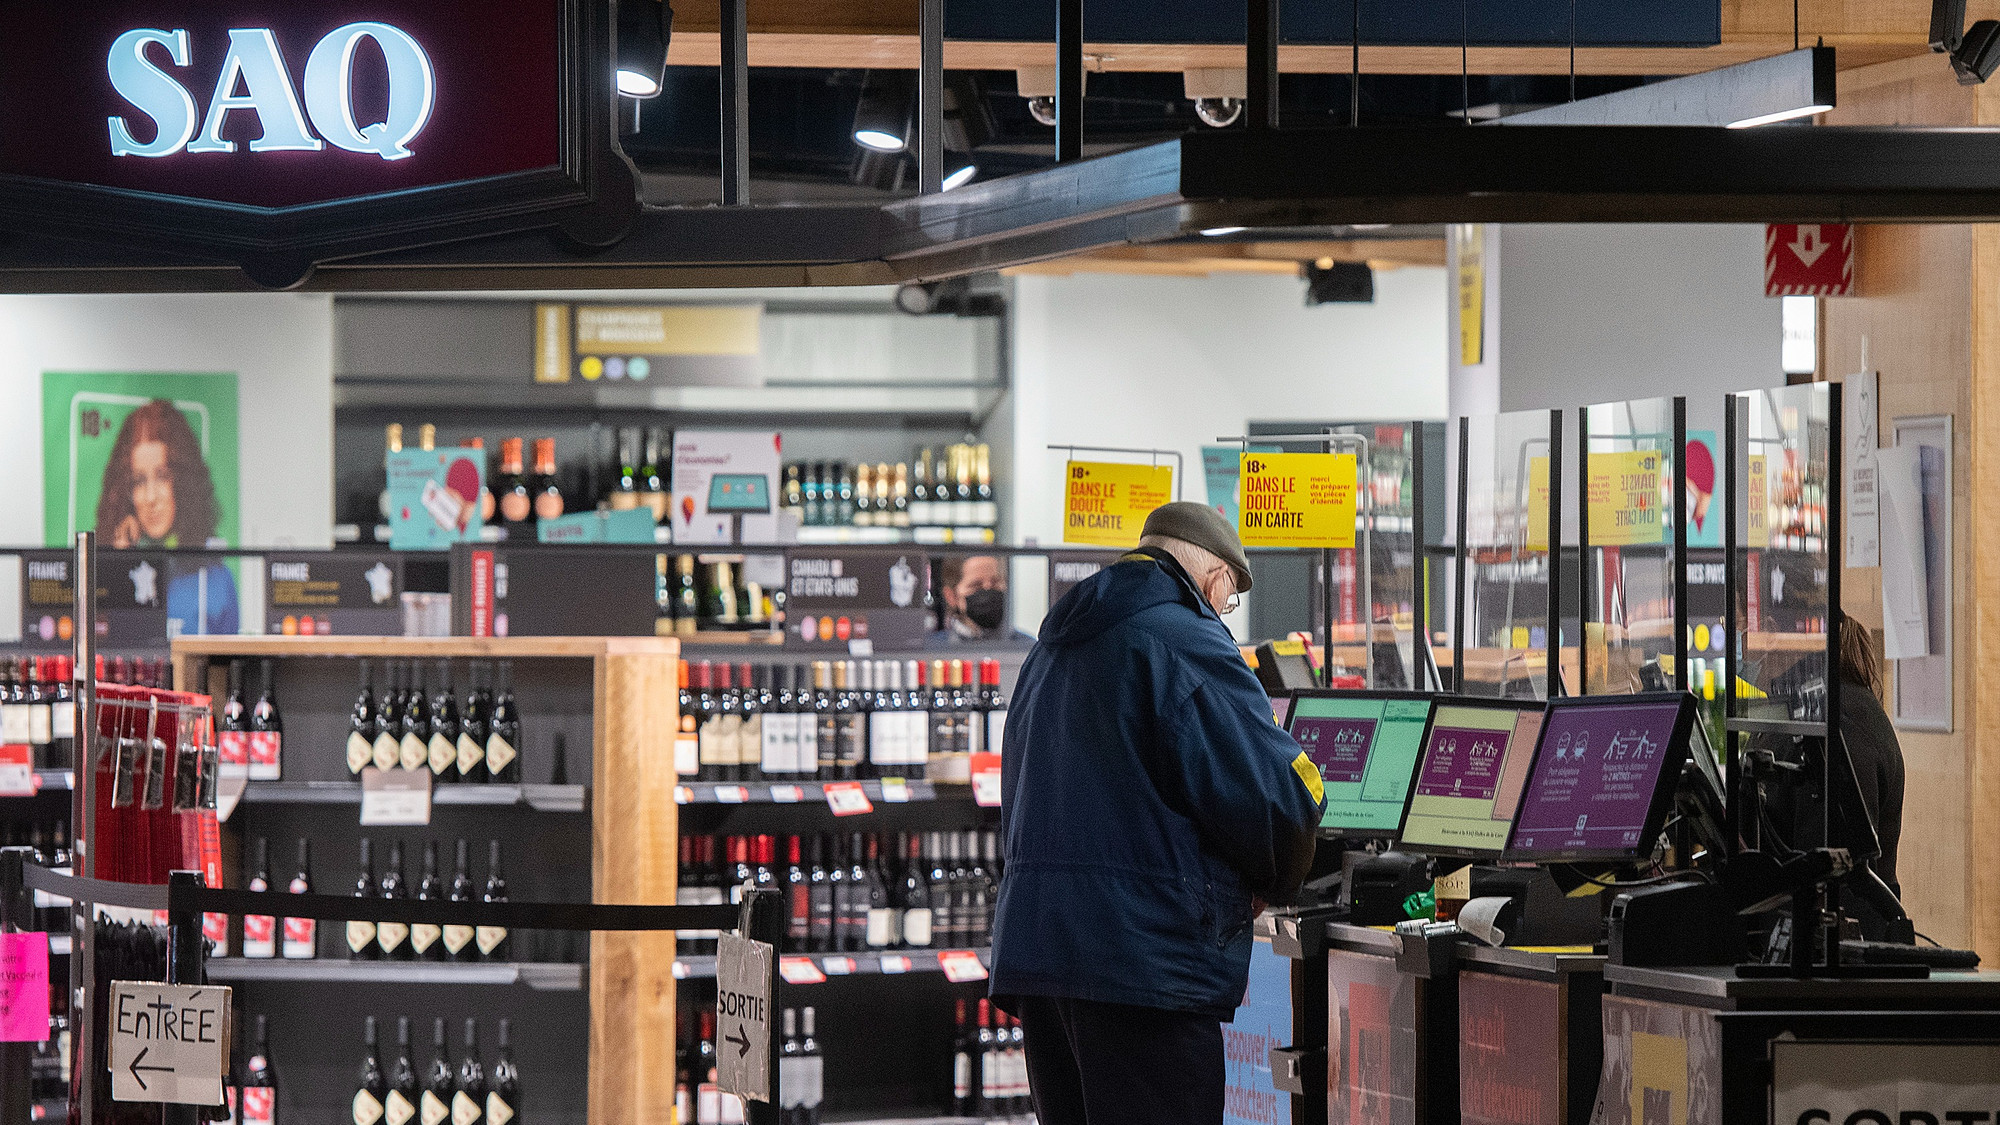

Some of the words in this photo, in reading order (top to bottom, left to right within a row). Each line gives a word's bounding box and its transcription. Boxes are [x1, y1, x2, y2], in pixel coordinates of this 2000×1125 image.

[107, 21, 437, 160] SAQ
[1072, 467, 1090, 478] 18+
[1246, 460, 1267, 473] 18+
[1071, 481, 1101, 497] DANS
[1103, 483, 1116, 498] LE
[1246, 476, 1279, 493] DANS
[1282, 476, 1296, 493] LE
[1320, 483, 1351, 491] préparer
[1246, 494, 1289, 511] DOUTE,
[1069, 513, 1085, 527] ON
[1088, 514, 1122, 530] CARTE
[1245, 512, 1263, 528] ON
[1265, 512, 1304, 528] CARTE
[28, 562, 68, 580] FRANCE
[271, 563, 310, 581] FRANCE
[719, 990, 764, 1022] SORTIE
[1222, 1023, 1265, 1083] appuyer
[1225, 1081, 1278, 1125] oducteurs
